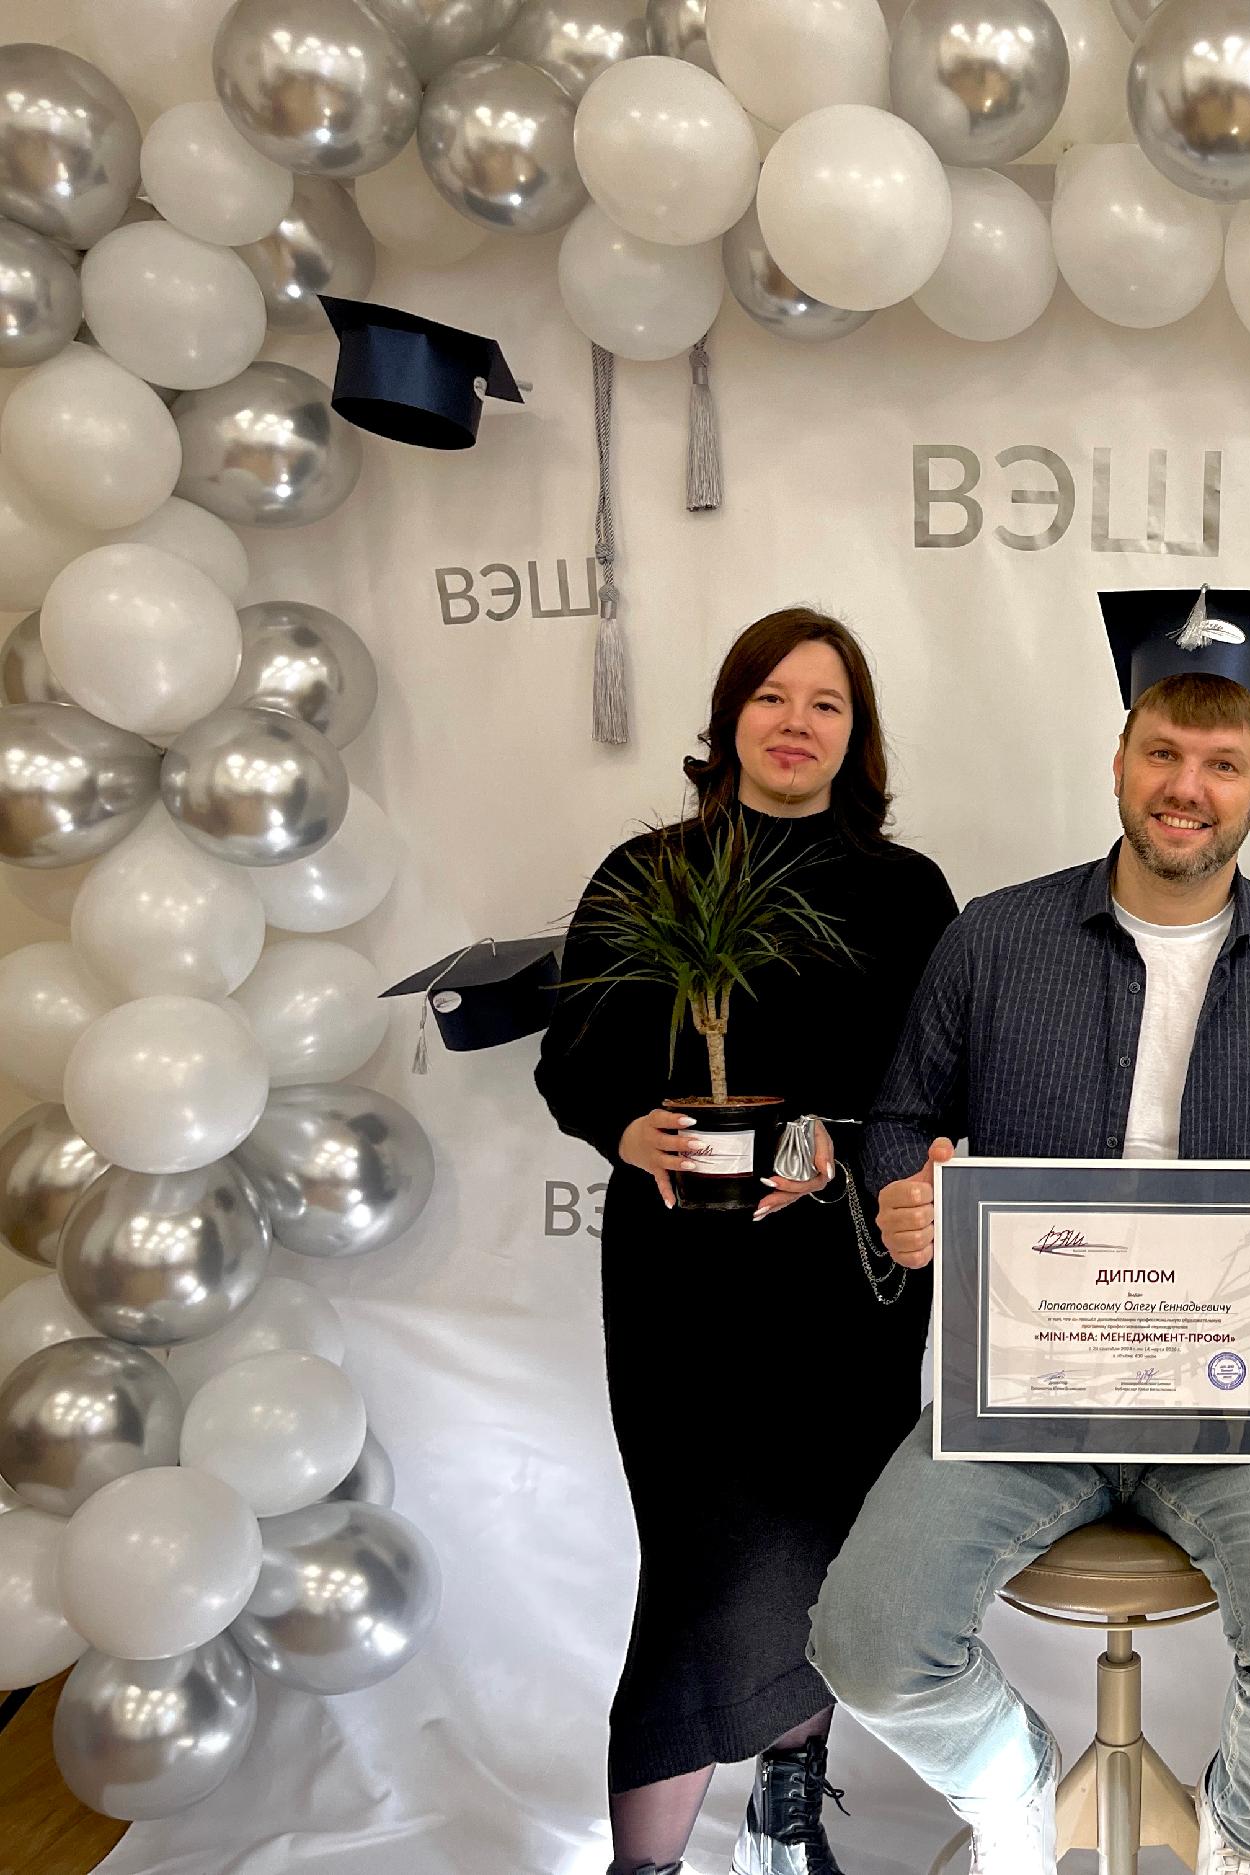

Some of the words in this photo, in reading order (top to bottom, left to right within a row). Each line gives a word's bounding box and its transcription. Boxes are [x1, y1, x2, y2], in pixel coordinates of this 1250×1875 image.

[913, 444, 1222, 557] ВЭШ
[435, 557, 599, 625] ВЭШ
[544, 1180, 608, 1239] ВЭ
[1096, 1269, 1175, 1285] ДИПЛОМ
[1038, 1299, 1121, 1313] Лопатовскому
[1124, 1300, 1156, 1313] Олегу
[1159, 1301, 1231, 1313] Геннадьевичу
[1035, 1331, 1098, 1341] «MINI-MBA:
[1100, 1332, 1235, 1343] МЕНЕДЖМЕНТ-ПРОФИ»
